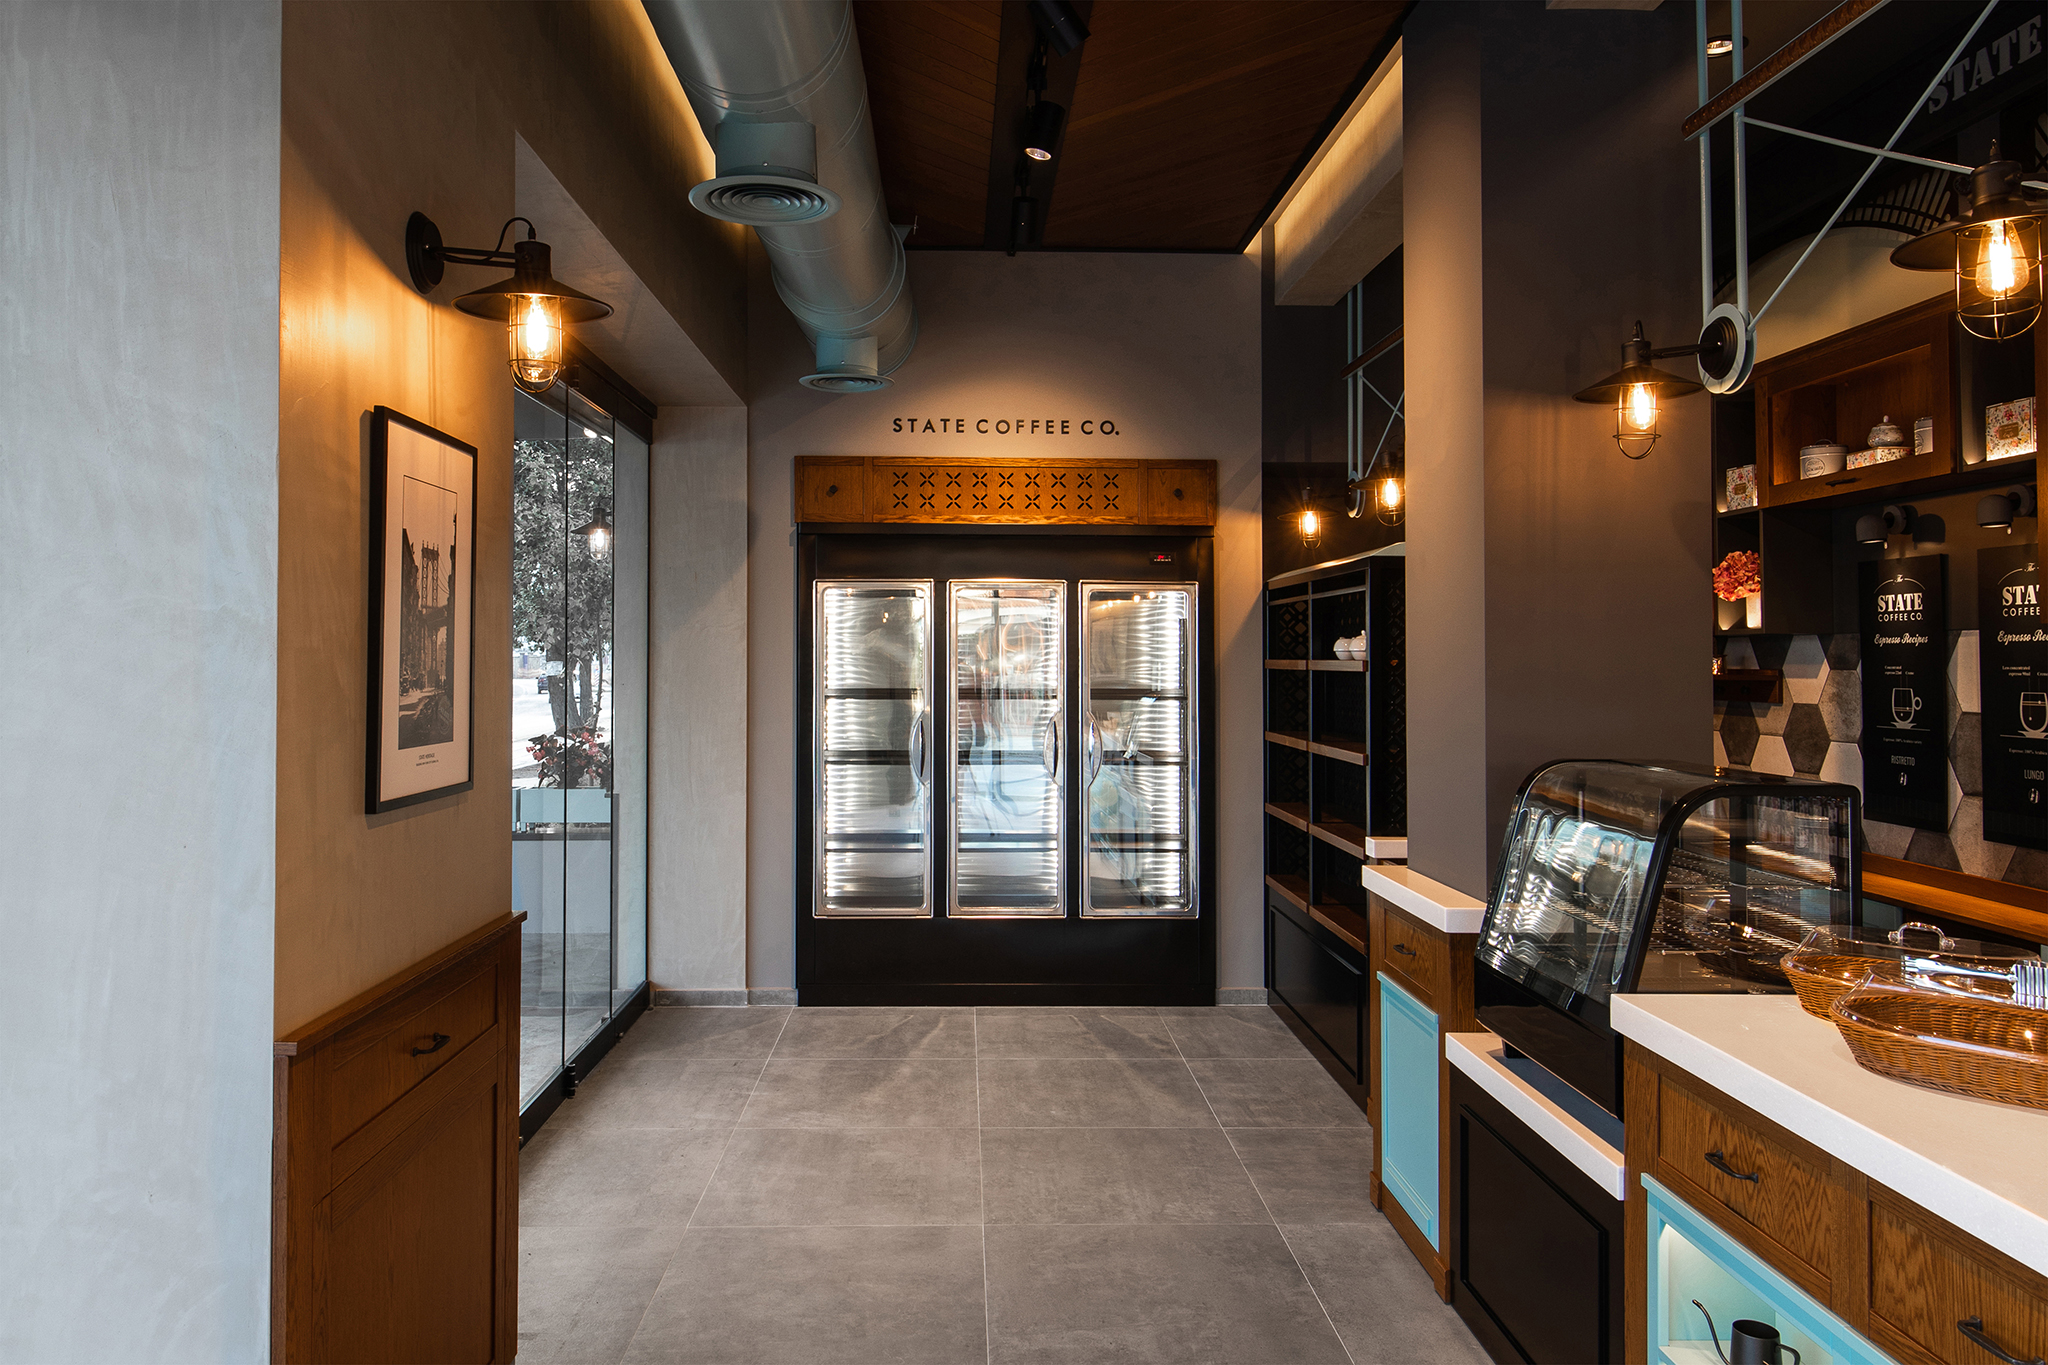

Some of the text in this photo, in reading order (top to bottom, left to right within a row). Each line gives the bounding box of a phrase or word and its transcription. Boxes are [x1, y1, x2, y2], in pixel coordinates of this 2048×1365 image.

[1928, 14, 2042, 114] STATE
[892, 417, 1120, 436] STATE COFFEE CO.
[1877, 592, 1923, 612] STATE
[2002, 585, 2040, 606] STA
[1877, 612, 1923, 622] COFFEE CO.
[2002, 606, 2040, 617] COFFEE
[1874, 632, 1928, 647] Espresso Recipes
[1997, 630, 2031, 645] Espresso
[1891, 755, 1915, 766] RISTRETTO
[2024, 769, 2044, 781] LUNGO
